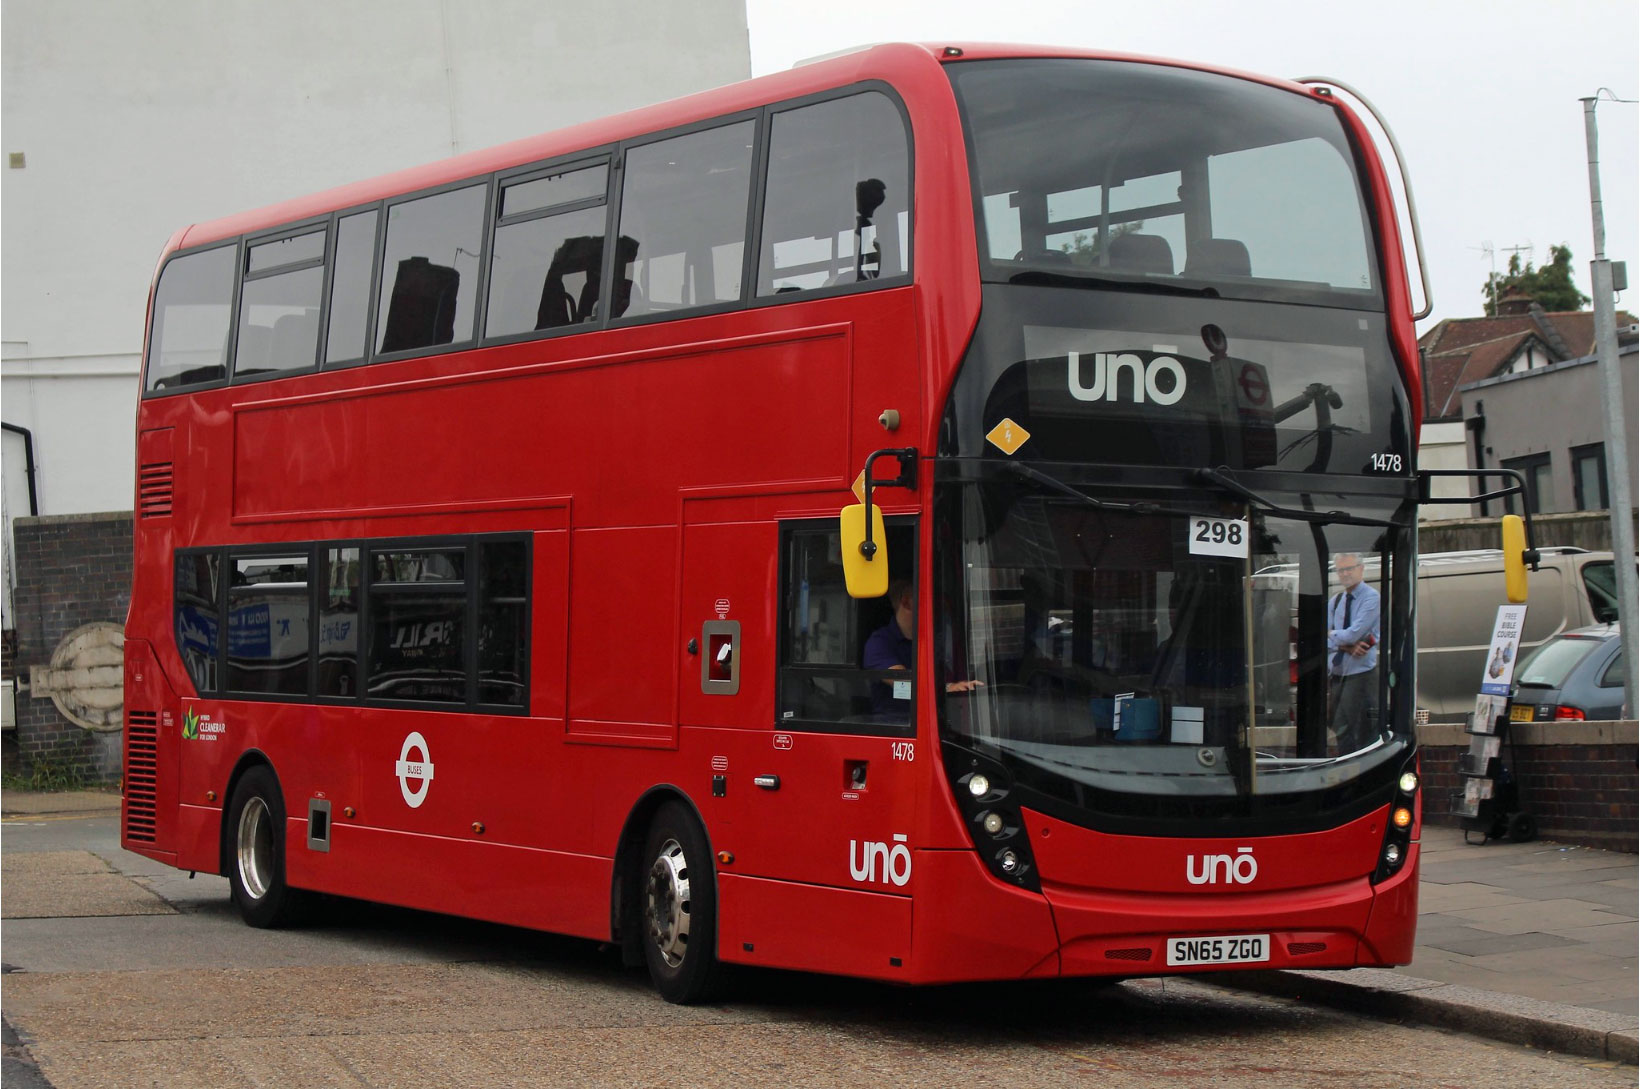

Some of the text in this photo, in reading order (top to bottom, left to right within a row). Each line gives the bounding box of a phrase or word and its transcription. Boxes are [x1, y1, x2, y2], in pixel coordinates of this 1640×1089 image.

[1371, 453, 1402, 472] 1478
[1196, 520, 1242, 545] 298
[891, 742, 914, 762] 1478
[408, 765, 422, 775] BUSES
[1175, 939, 1262, 961] SN65 ZGO
